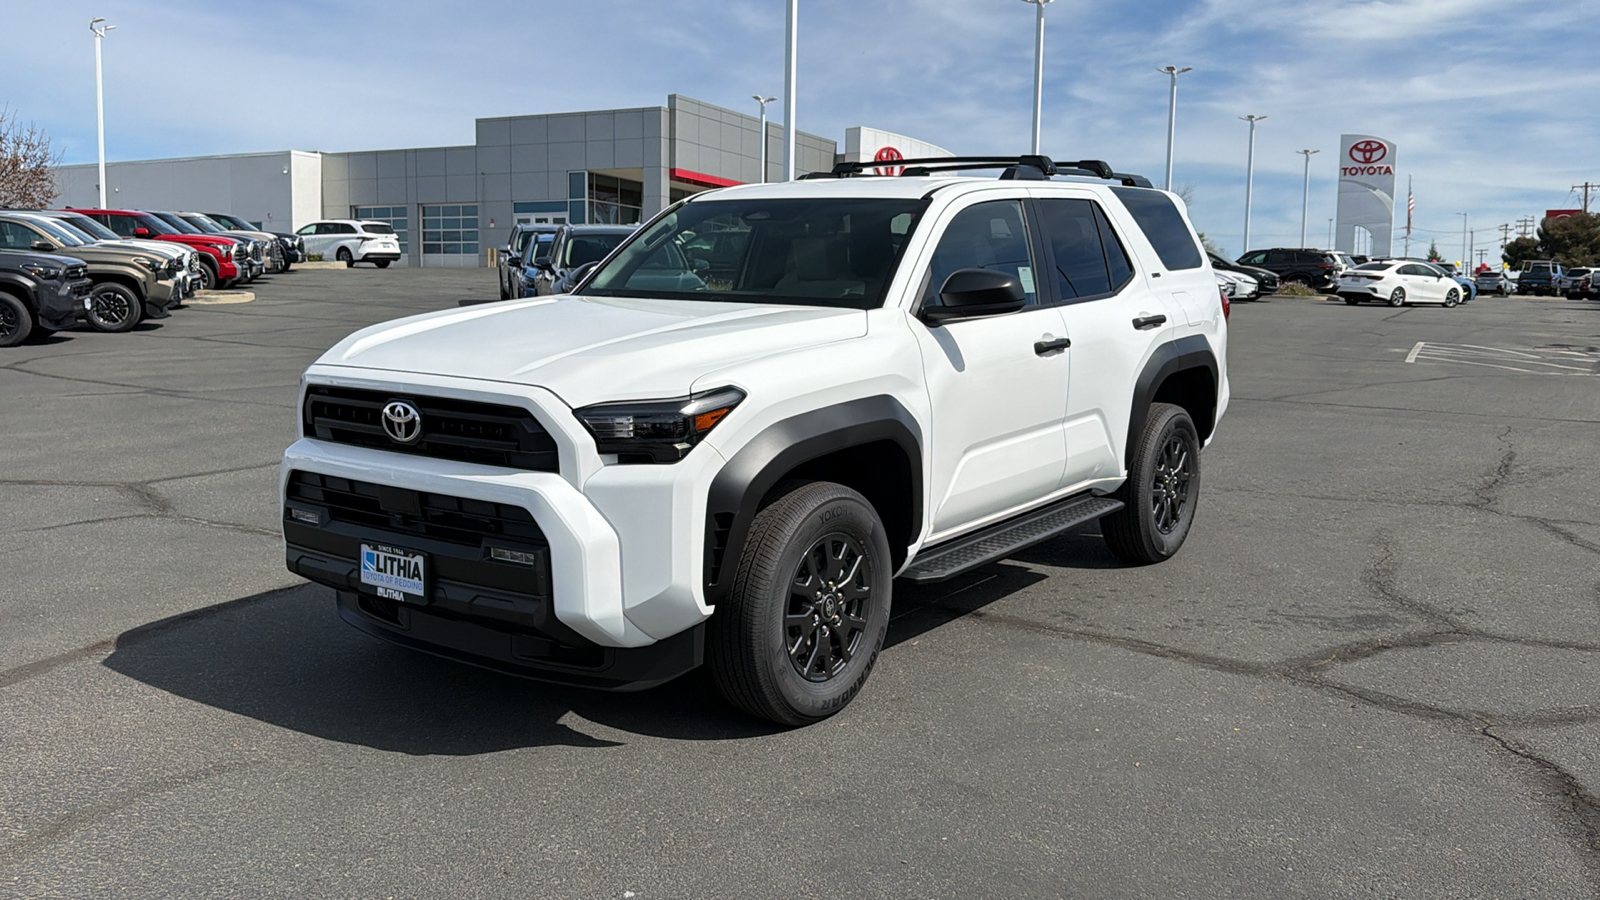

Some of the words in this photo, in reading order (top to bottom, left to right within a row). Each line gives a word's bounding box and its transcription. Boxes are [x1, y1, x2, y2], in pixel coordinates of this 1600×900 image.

[1341, 165, 1393, 176] TOYOTA
[378, 545, 392, 553] SINCE
[376, 554, 422, 581] LITHIA
[363, 571, 385, 582] TOYOTA
[385, 575, 393, 583] OF
[394, 577, 423, 591] REDDING
[383, 588, 405, 602] LITHIA
